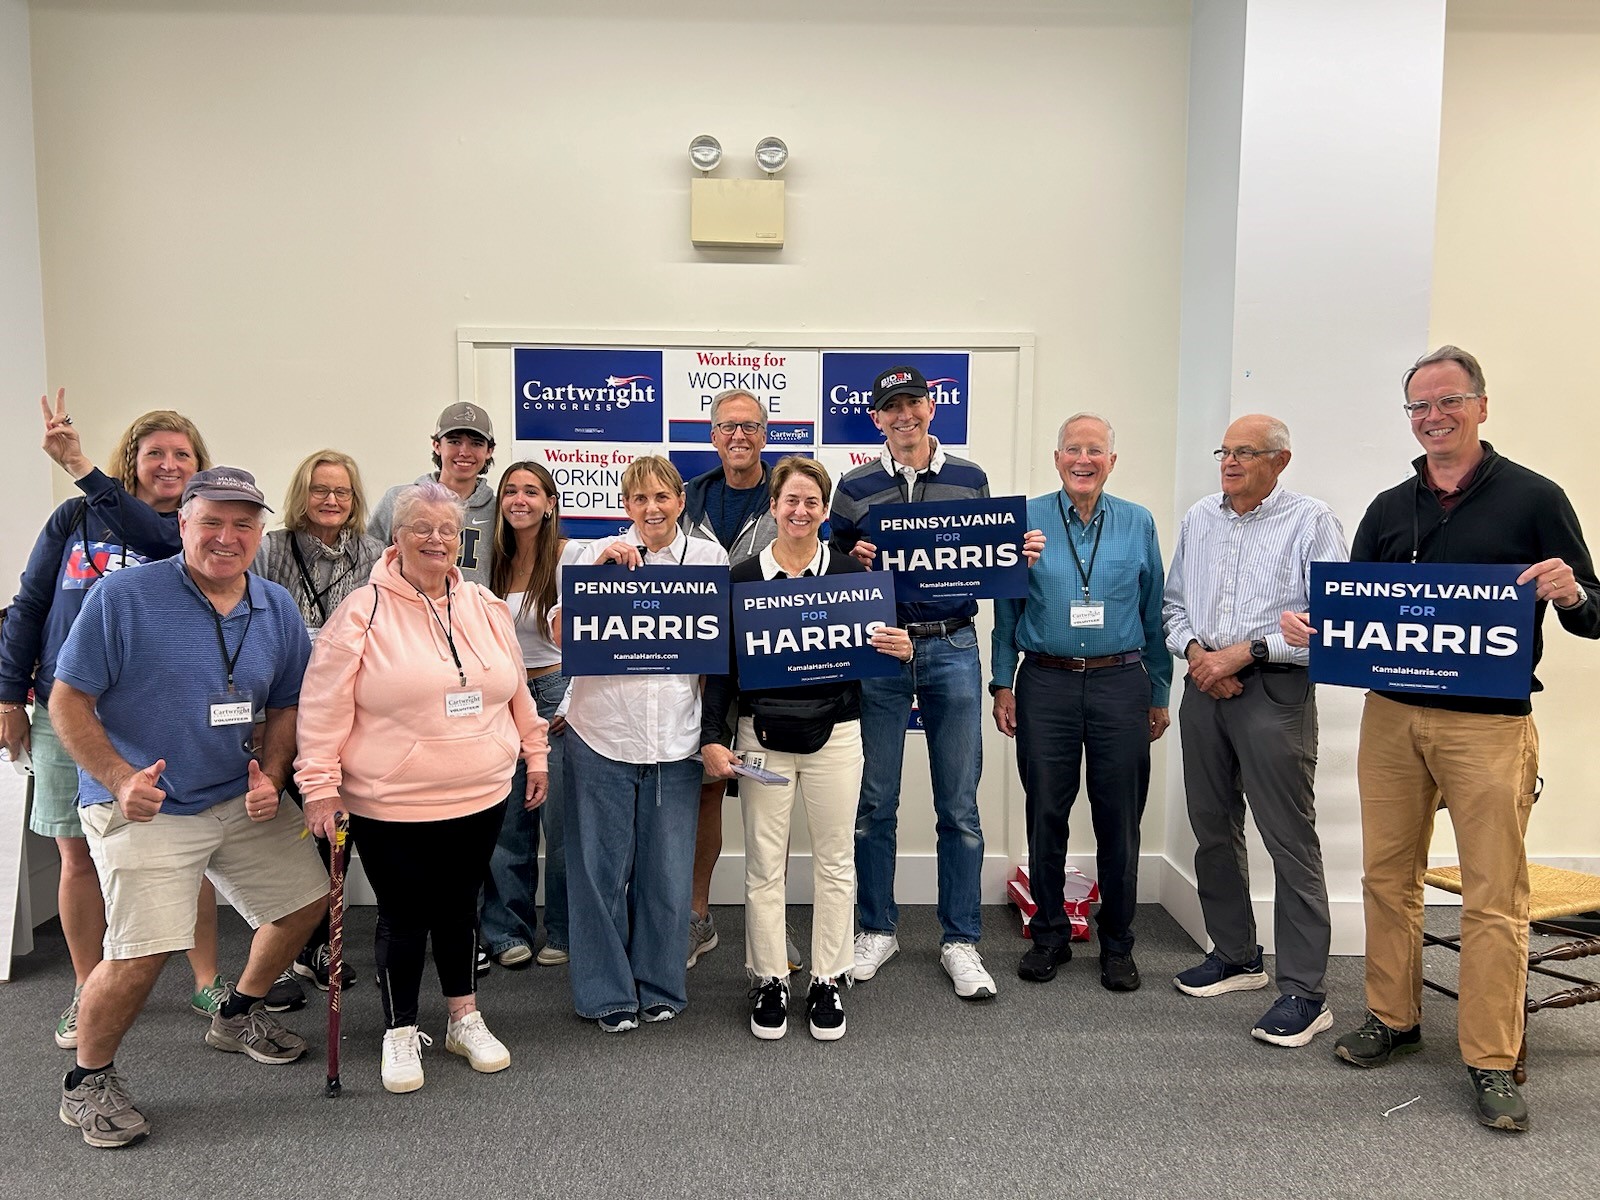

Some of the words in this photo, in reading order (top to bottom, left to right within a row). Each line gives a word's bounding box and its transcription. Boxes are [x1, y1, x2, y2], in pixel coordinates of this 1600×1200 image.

[697, 352, 760, 371] Working
[764, 352, 786, 367] for
[688, 372, 787, 390] WORKING
[880, 372, 913, 389] BIDEN
[523, 379, 655, 409] Cartwright
[830, 384, 960, 405] Carht
[523, 402, 612, 412] CONGRESS
[770, 430, 809, 440] Cartwright
[544, 449, 609, 468] Working
[612, 450, 635, 464] for
[551, 469, 626, 487] ORKIN
[880, 512, 1016, 531] PENNSYLVANIA
[935, 533, 961, 543] FOR
[881, 542, 1019, 572] HARRIS
[574, 581, 718, 595] PENNSYLVANIA
[919, 580, 981, 589] KamalaHarris.com
[1325, 581, 1519, 601] PENNSYLVANIA
[633, 600, 660, 610] FOR
[744, 588, 883, 611] PENNSYLVANIA
[801, 610, 828, 622] FOR
[1400, 605, 1436, 617] FOR
[573, 614, 720, 641] HARRIS
[1322, 619, 1519, 657] HARRIS
[613, 653, 679, 661] KamalaHarris.com
[787, 661, 851, 672] KamalaHarris.com
[1372, 665, 1459, 677] KamalaHarris.com
[448, 696, 480, 706] Cartwright
[213, 707, 250, 716] Cartwright
